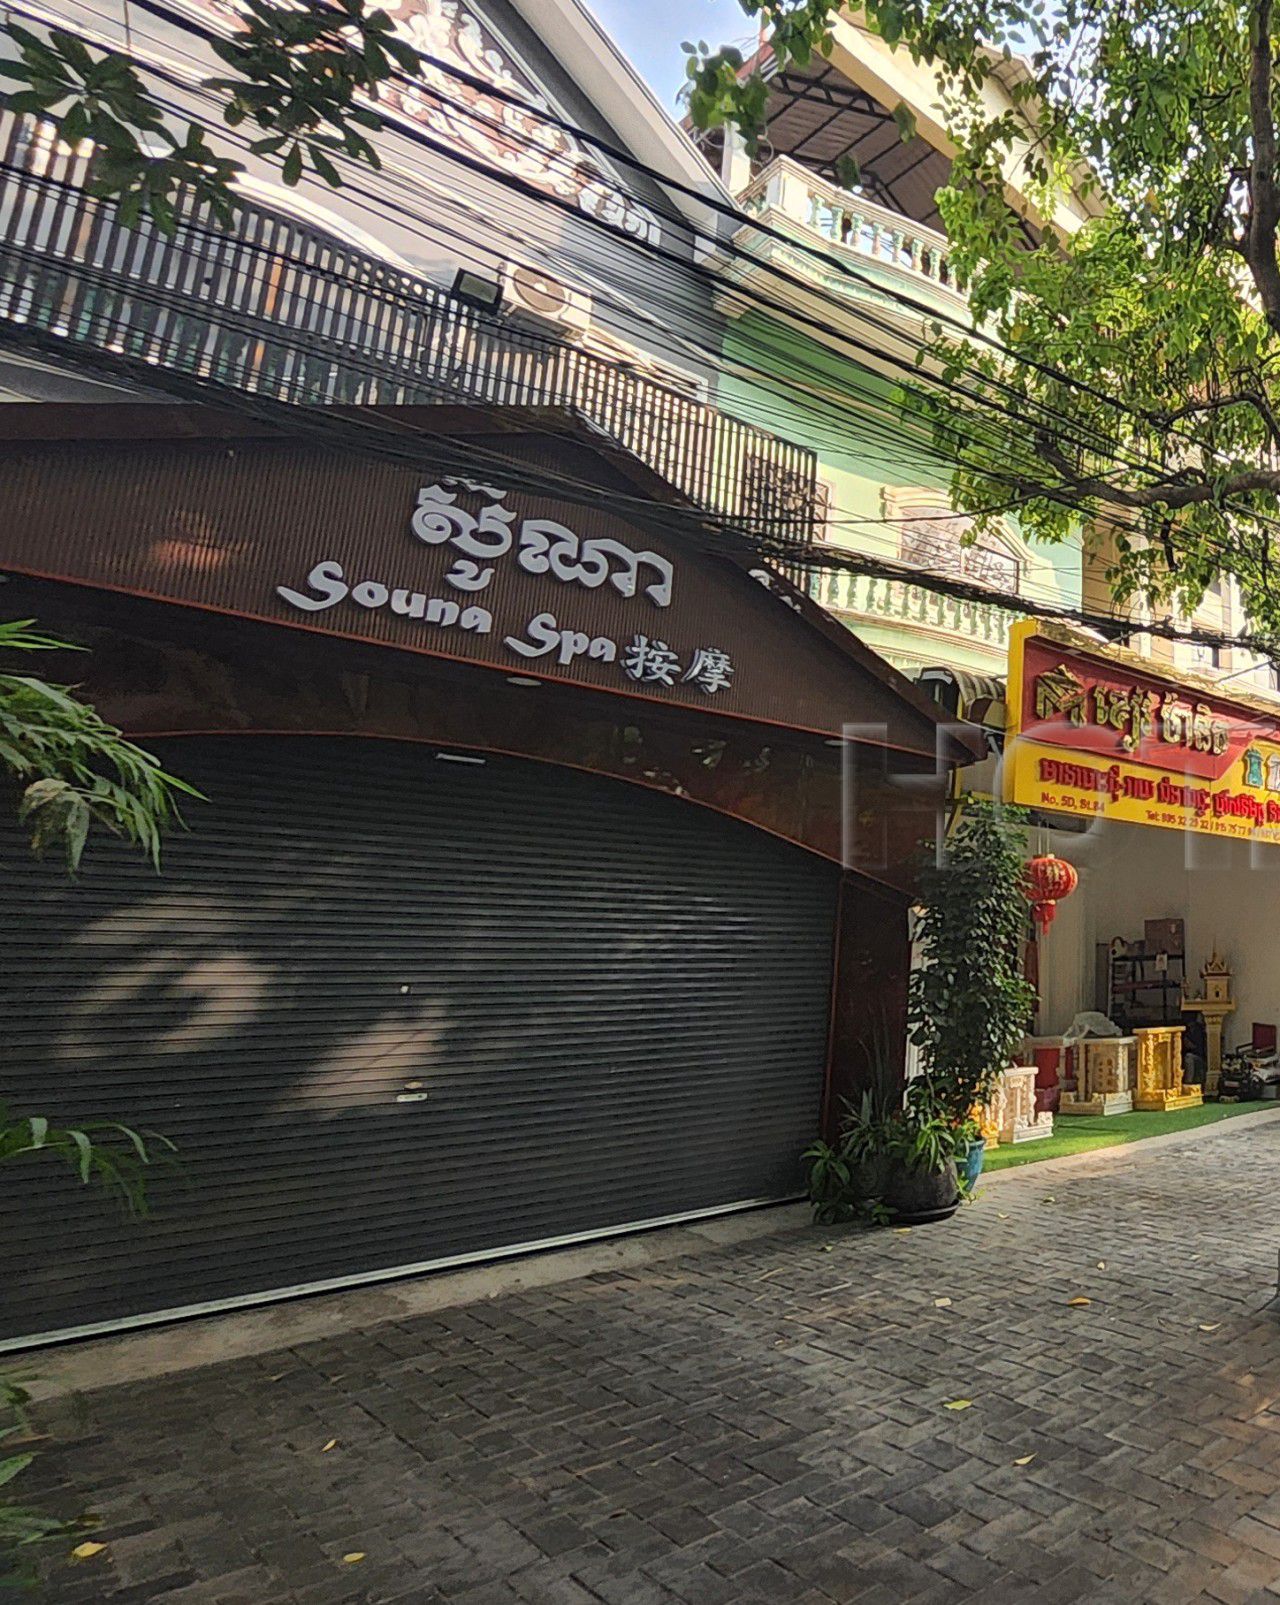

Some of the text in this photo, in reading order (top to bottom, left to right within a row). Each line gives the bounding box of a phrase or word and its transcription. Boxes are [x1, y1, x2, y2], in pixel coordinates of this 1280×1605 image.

[276, 560, 736, 696] Souna Spa 按摩
